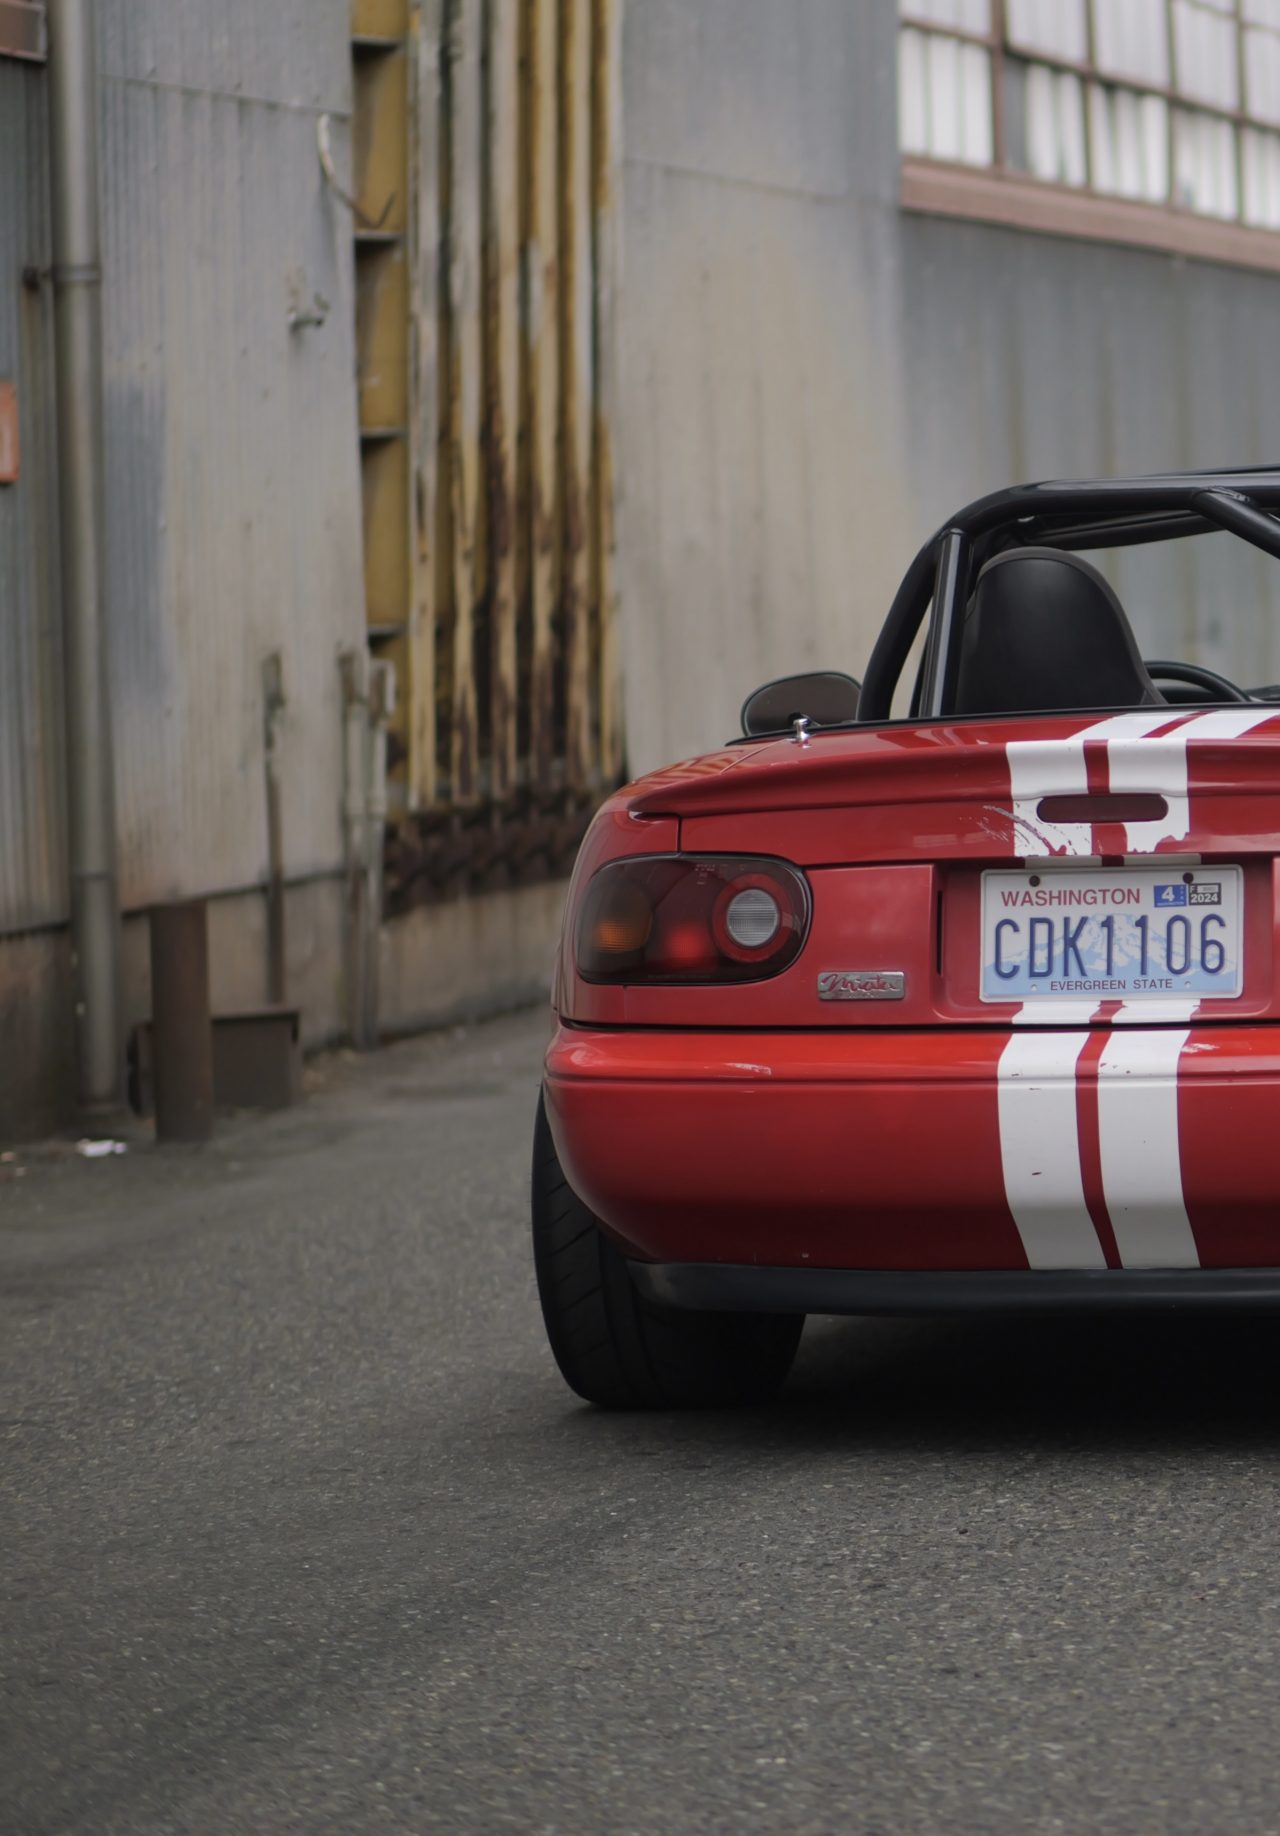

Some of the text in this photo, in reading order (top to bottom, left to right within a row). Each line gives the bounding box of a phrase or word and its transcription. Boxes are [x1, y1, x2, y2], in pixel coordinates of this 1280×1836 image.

[1001, 888, 1141, 907] WASHINGTON
[1161, 886, 1175, 902] 4
[1190, 893, 1218, 903] 2024
[995, 913, 1226, 979] CDK1106
[820, 973, 899, 992] Miata
[1050, 979, 1173, 991] EVERGREEN STATE
